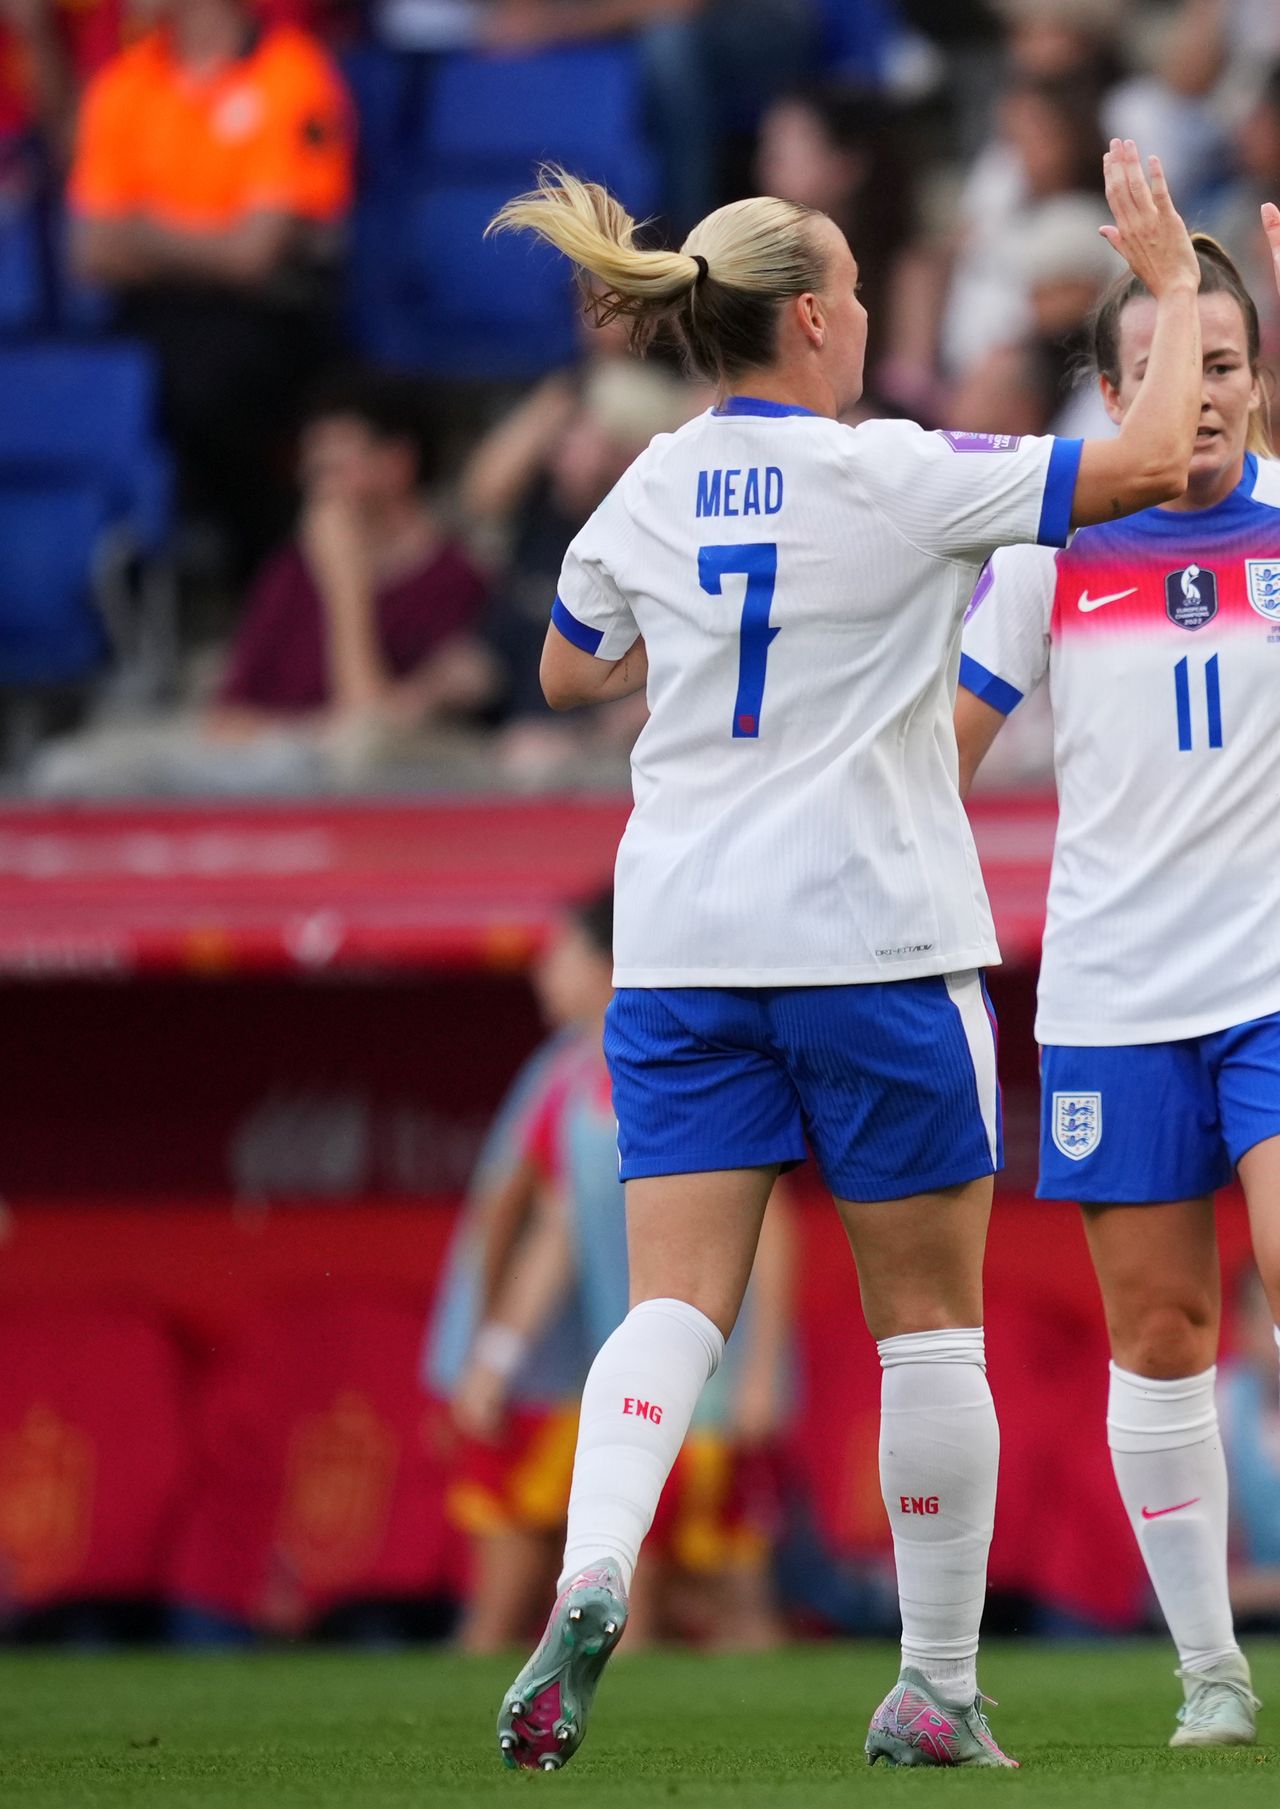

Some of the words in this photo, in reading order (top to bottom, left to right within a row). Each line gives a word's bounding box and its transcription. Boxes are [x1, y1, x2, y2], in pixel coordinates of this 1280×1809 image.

[695, 466, 784, 518] MEAD
[697, 543, 782, 738] 7
[1174, 652, 1223, 751] 11
[622, 1397, 663, 1425] ENG
[899, 1495, 940, 1515] ENG
